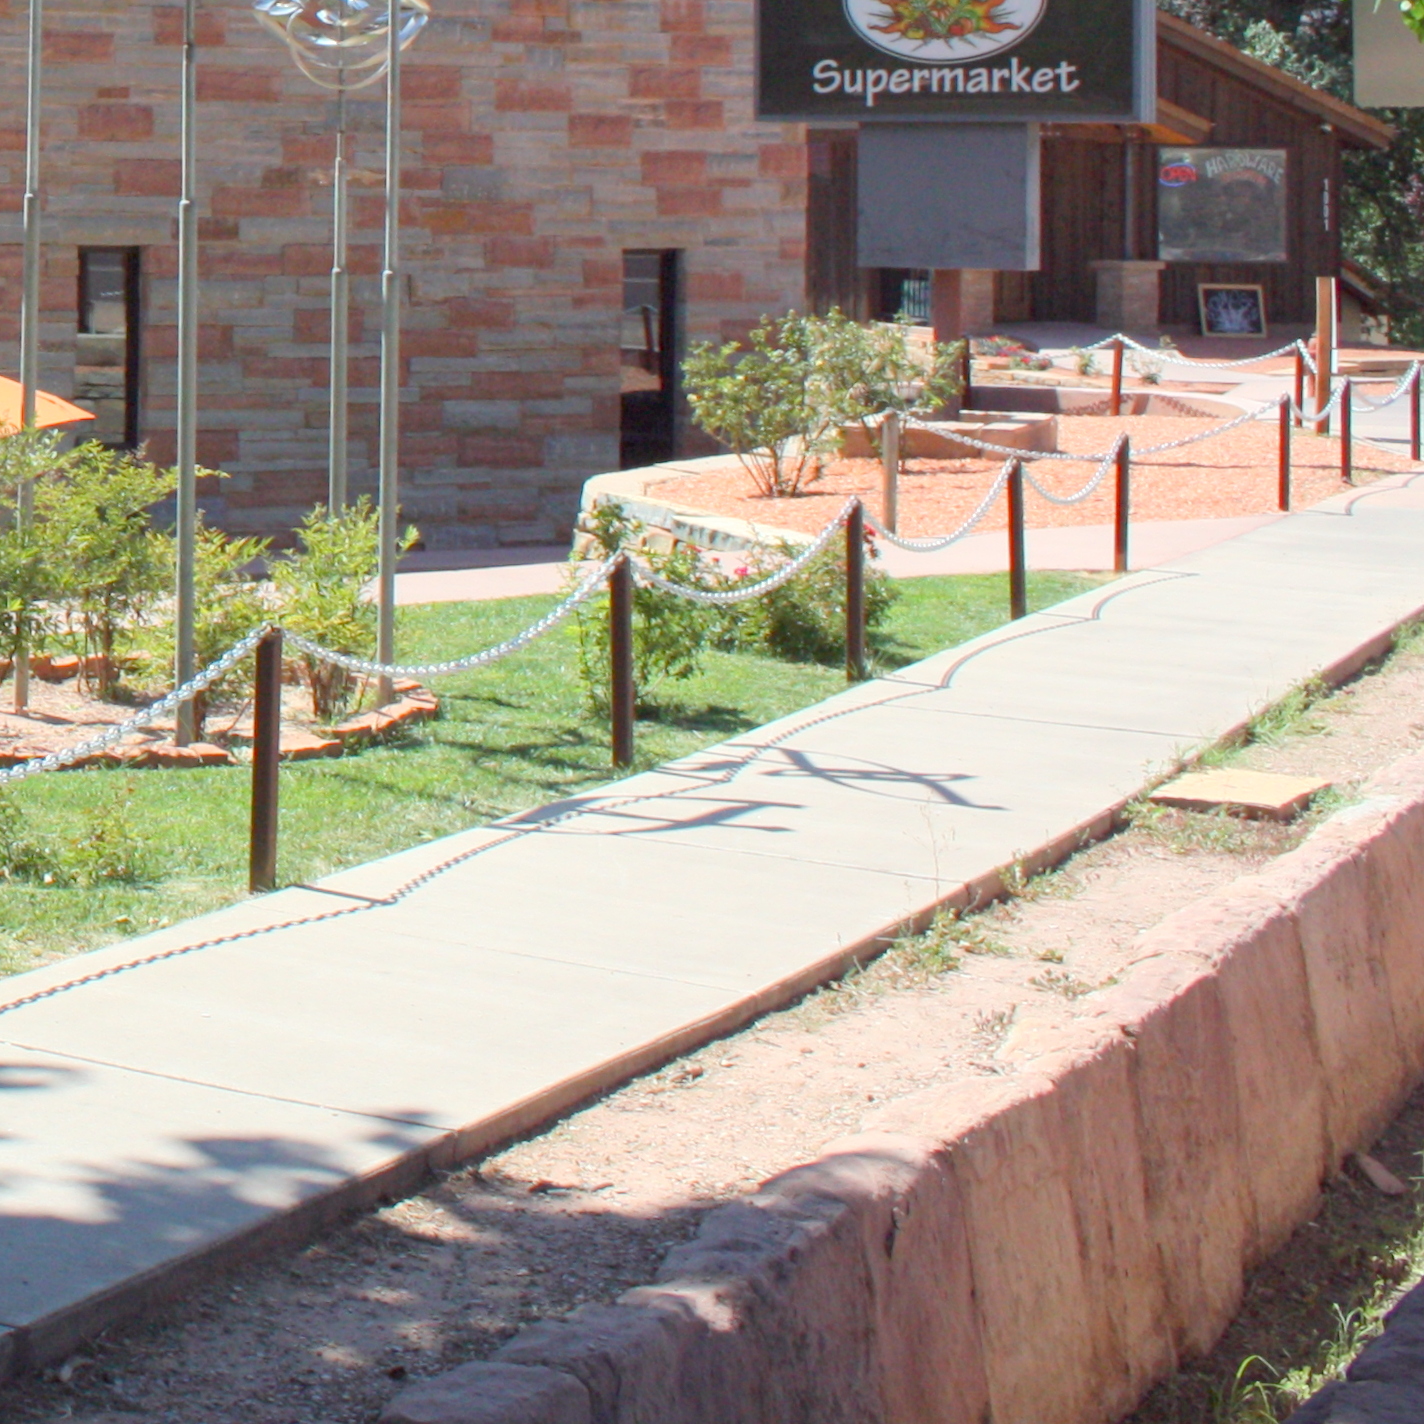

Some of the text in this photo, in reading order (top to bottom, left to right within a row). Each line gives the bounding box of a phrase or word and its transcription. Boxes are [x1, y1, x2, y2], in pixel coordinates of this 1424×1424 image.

[812, 57, 1080, 107] Supermarket
[1160, 165, 1198, 183] OPEN
[1205, 153, 1285, 185] HARDWARE
